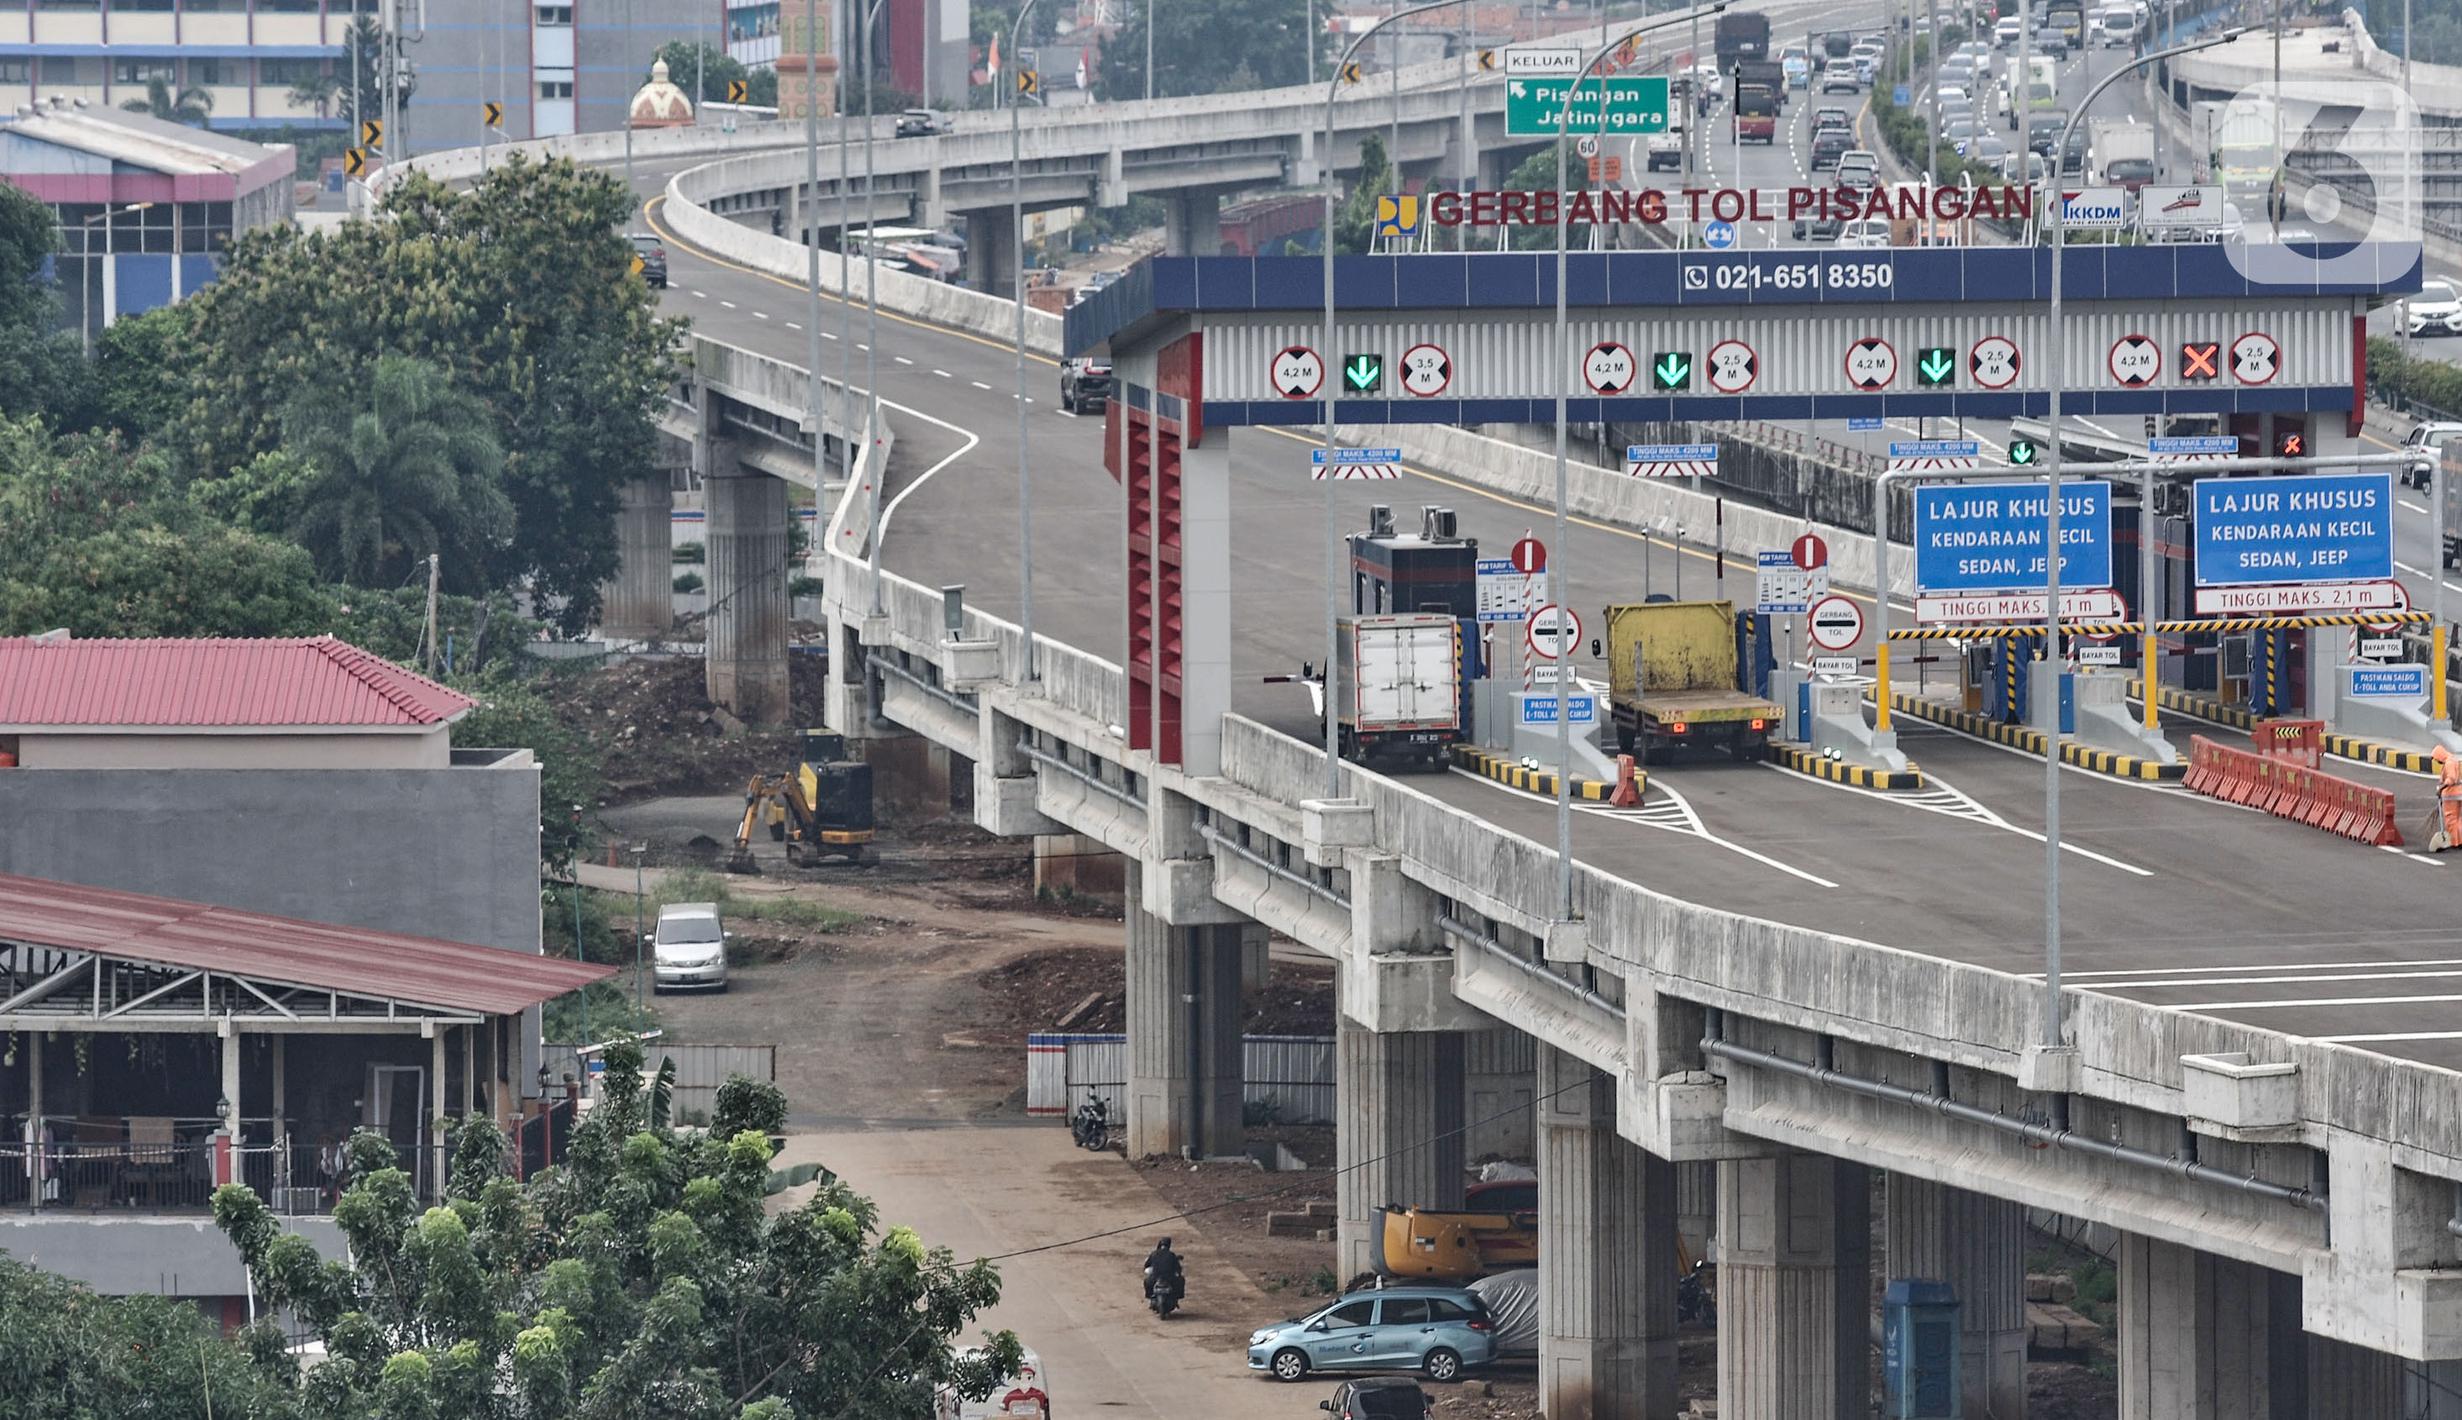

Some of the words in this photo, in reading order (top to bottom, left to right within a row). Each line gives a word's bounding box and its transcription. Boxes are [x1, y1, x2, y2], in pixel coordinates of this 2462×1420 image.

[1512, 55, 1574, 66] KELUAR
[1535, 87, 1639, 105] Pisangan
[1536, 110, 1663, 128] Jatinegara
[1580, 141, 1595, 153] 60
[1431, 189, 1668, 226] GERBANG
[1682, 188, 1774, 223] TOL
[1787, 184, 2032, 222] PISANGAN
[1715, 264, 1819, 290] 021-651
[1828, 263, 1893, 289] 8350
[1987, 351, 2004, 362] 2,5
[2246, 347, 2263, 358] 2,5
[1723, 355, 1741, 366] 2,5
[1857, 359, 1873, 369] 4,2
[1876, 359, 1886, 368] M
[2120, 356, 2137, 367] 4,2
[2140, 355, 2150, 365] M
[1594, 363, 1612, 373] 4,2
[1614, 362, 1624, 372] M
[1990, 366, 2000, 375] M
[2250, 362, 2260, 371] M
[1283, 368, 1299, 378] 4,2
[1302, 368, 1312, 377] M
[1421, 373, 1431, 383] M
[1727, 370, 1737, 379] M
[1632, 448, 1657, 456] TINGGI
[2209, 492, 2280, 514] LAJUR
[2289, 489, 2376, 511] KHUSUS
[1929, 501, 1999, 520] LAJUR
[2211, 522, 2321, 541] KENDARAAN
[2327, 521, 2376, 537] KECIL
[1931, 530, 2041, 548] KENDARAAN
[2058, 529, 2095, 545] ECIL
[2239, 550, 2302, 569] SEDAN,
[2309, 549, 2349, 566] JEEP
[1958, 558, 2021, 576] SEDAN,
[2028, 556, 2068, 573] JEP
[2220, 592, 2271, 608] TINGGI
[2278, 590, 2325, 605] MAKS.
[2333, 590, 2352, 606] 2,1
[2359, 590, 2373, 602] m
[1940, 602, 1991, 616] TINGGI
[1999, 600, 2045, 615] MAKS.
[2079, 600, 2092, 612] m
[1819, 611, 1853, 619] GERBANG
[2387, 643, 2400, 651] TOL
[2105, 651, 2118, 659] TOL
[1817, 661, 1840, 670] BAYAR
[1841, 661, 1854, 669] TOL
[2360, 674, 2393, 682] PASTIKAN
[2393, 673, 2416, 681] SALDO
[2354, 683, 2376, 691] E-TOLL
[2398, 682, 2420, 691] CUKUP
[1530, 701, 1558, 709] PASTIKA
[1567, 700, 1586, 708] ALDO
[1525, 711, 1549, 720] E-TOLL
[1569, 711, 1592, 719] CUKUP
